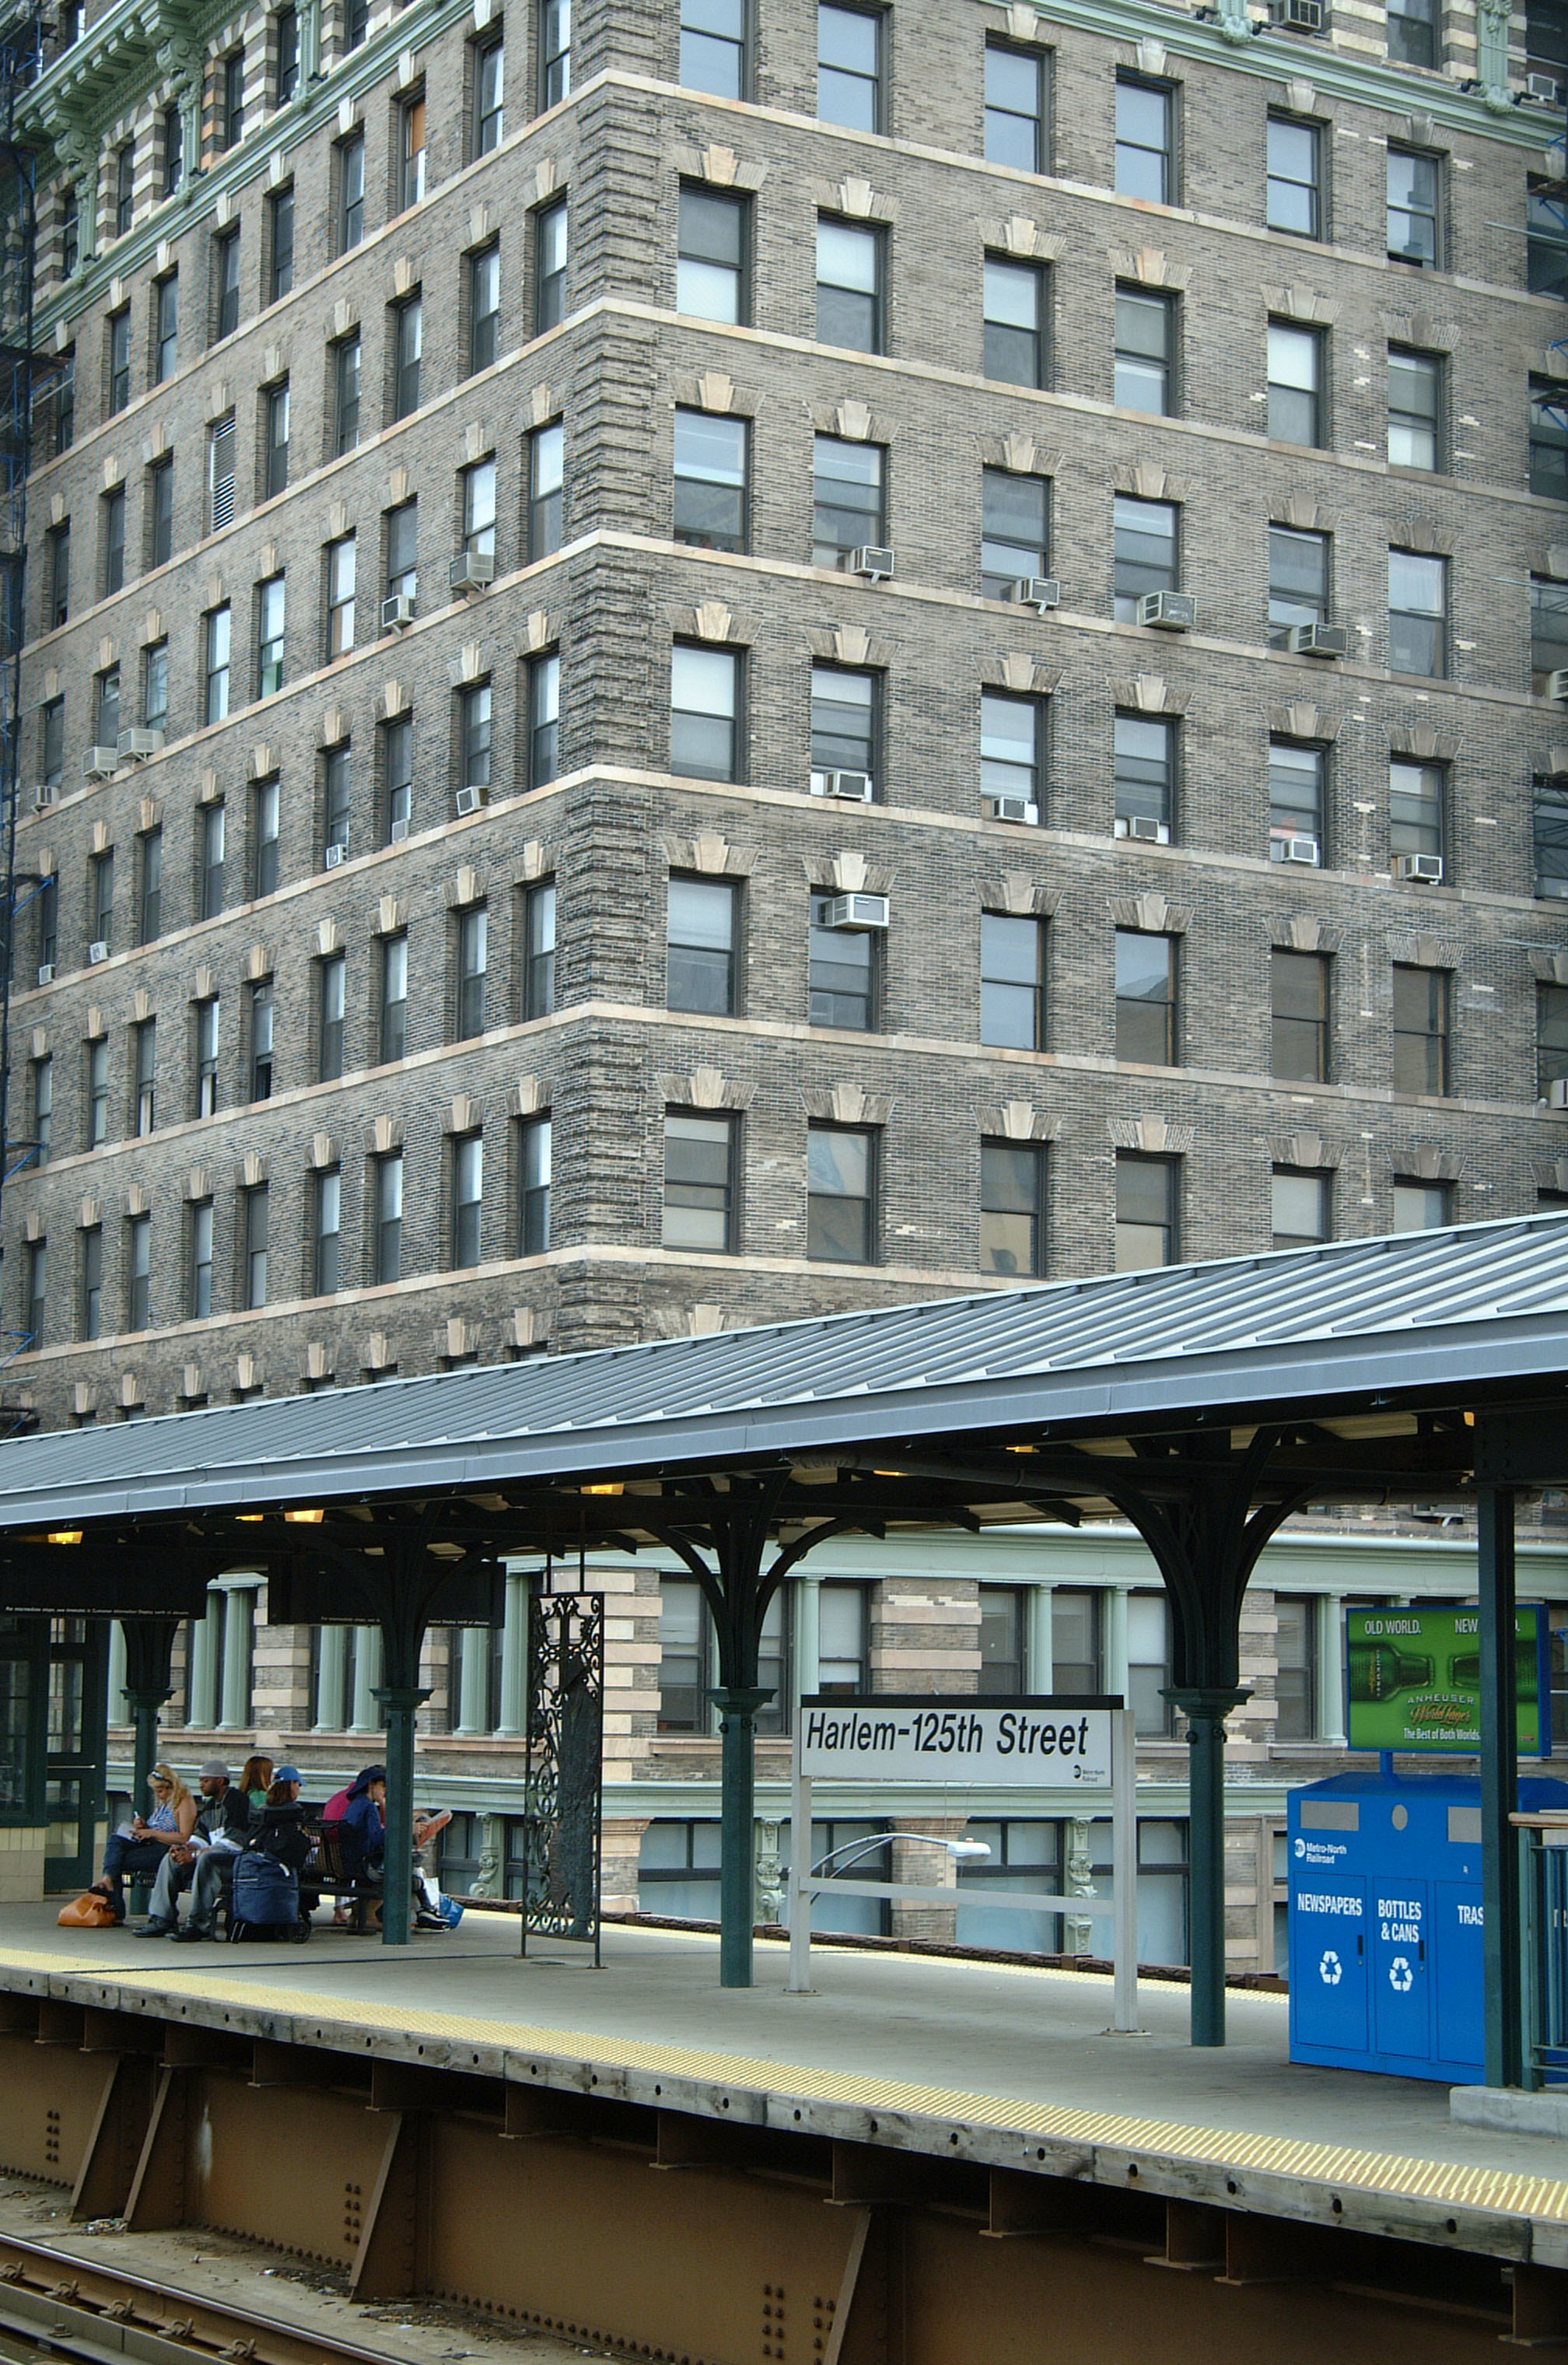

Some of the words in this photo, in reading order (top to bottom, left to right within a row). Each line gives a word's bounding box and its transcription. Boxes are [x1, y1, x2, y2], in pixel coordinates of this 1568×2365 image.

[1364, 1620, 1383, 1634] OLD
[1386, 1619, 1422, 1634] WORLD.
[1455, 1618, 1479, 1633] NEW
[1408, 1694, 1474, 1705] ANHEUSER
[807, 1712, 983, 1754] Harlem-125th
[996, 1712, 1089, 1756] Street
[1403, 1727, 1416, 1740] The
[1416, 1727, 1431, 1740] Best
[1432, 1728, 1439, 1740] of
[1440, 1728, 1456, 1740] Both
[1297, 1893, 1363, 1917] NEWSPAPERS
[1378, 1899, 1422, 1921] BOTTLES
[1457, 1905, 1484, 1925] TRAS
[1381, 1922, 1390, 1941] &
[1391, 1922, 1419, 1943] CANS
